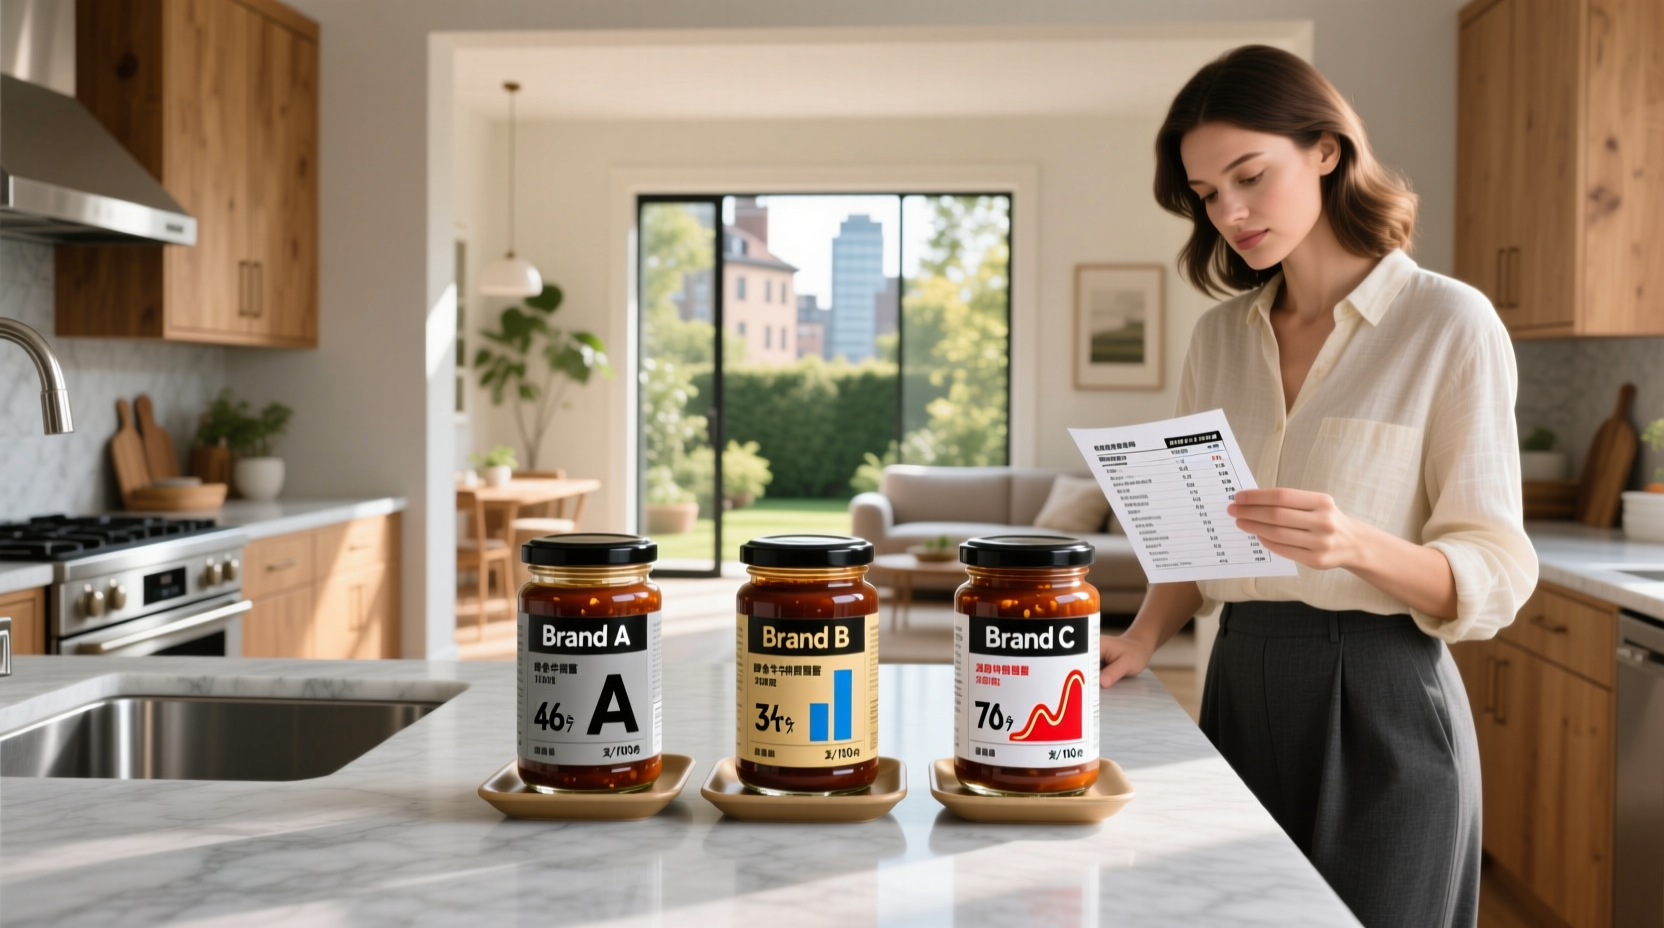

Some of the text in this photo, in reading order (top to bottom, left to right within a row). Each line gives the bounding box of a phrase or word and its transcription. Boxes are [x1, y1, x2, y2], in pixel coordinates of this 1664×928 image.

[542, 624, 631, 648] Brand A
[762, 625, 850, 649] Brand B
[985, 625, 1076, 650] Brand C
[586, 673, 639, 736] A
